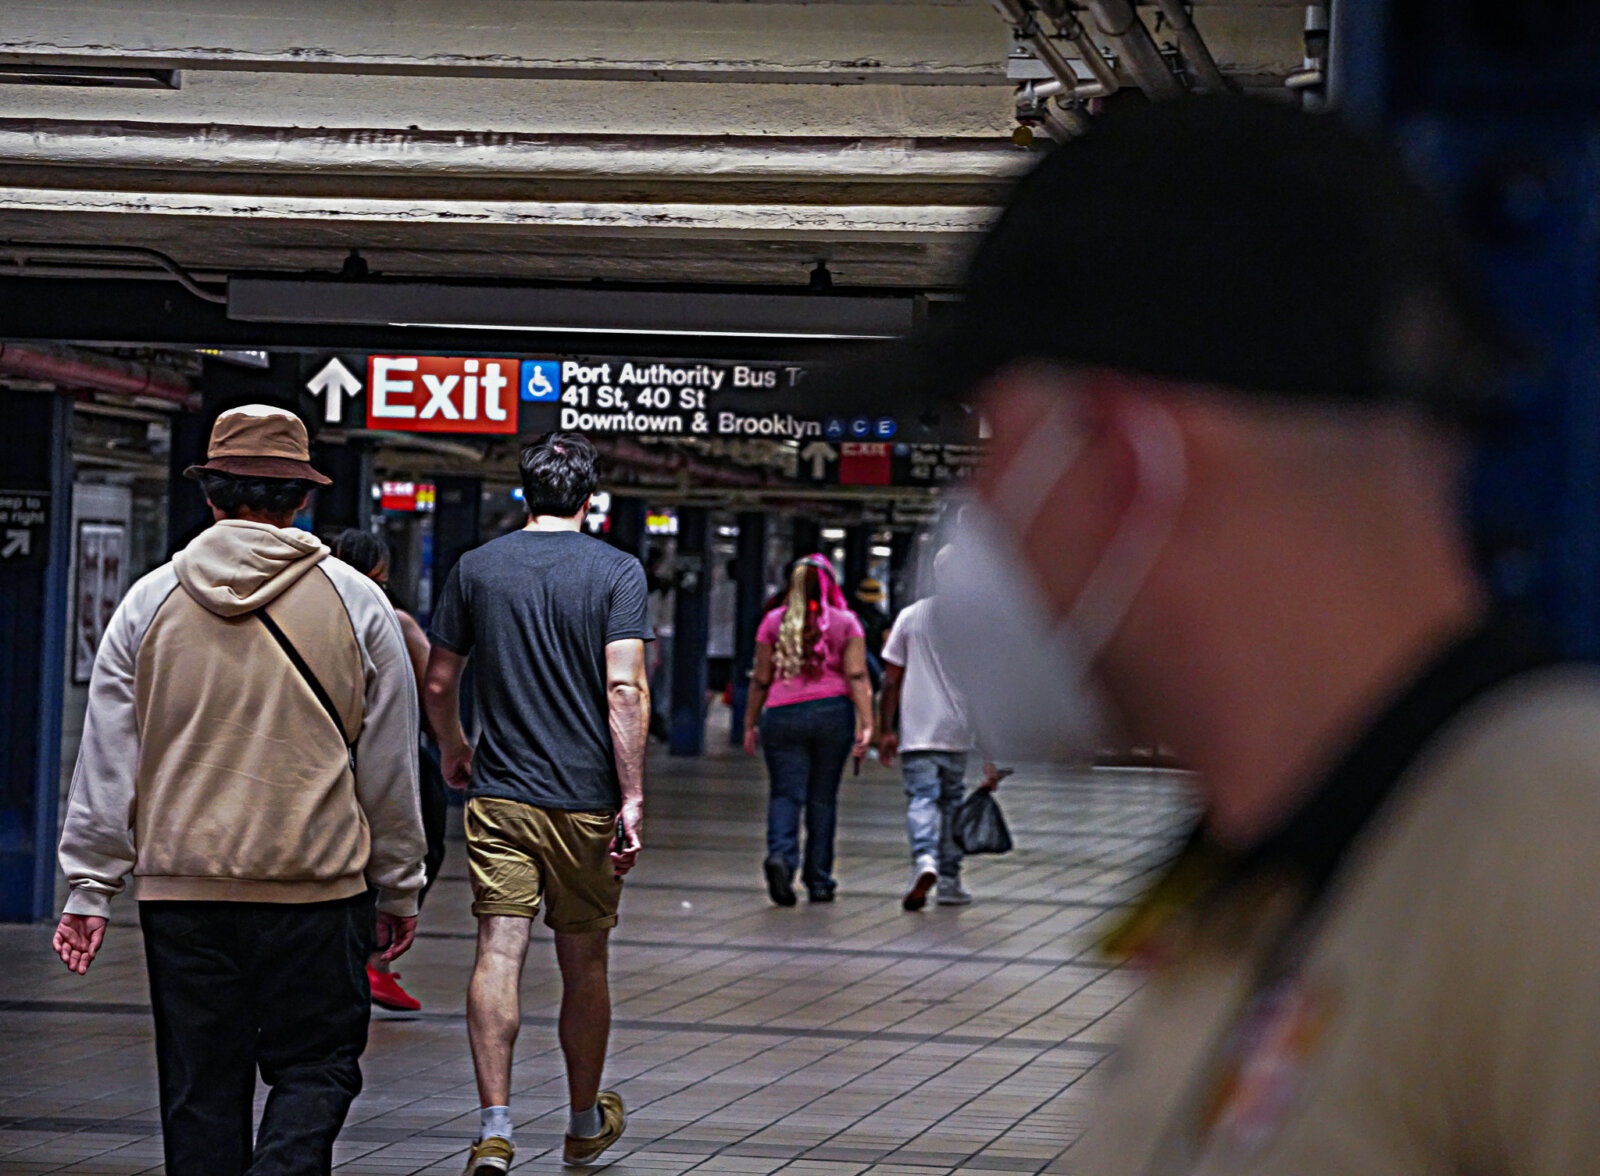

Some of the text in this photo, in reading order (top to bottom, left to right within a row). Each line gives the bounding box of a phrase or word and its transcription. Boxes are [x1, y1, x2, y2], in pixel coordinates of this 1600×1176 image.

[371, 356, 508, 422] Exit
[562, 360, 611, 384] Port
[618, 362, 725, 391] Authority
[733, 365, 776, 388] Bus
[561, 385, 706, 410] 41 St, 40 St
[560, 408, 892, 439] Downtown & Brooklyn A C E
[26, 496, 41, 510] to
[11, 511, 45, 527] right
